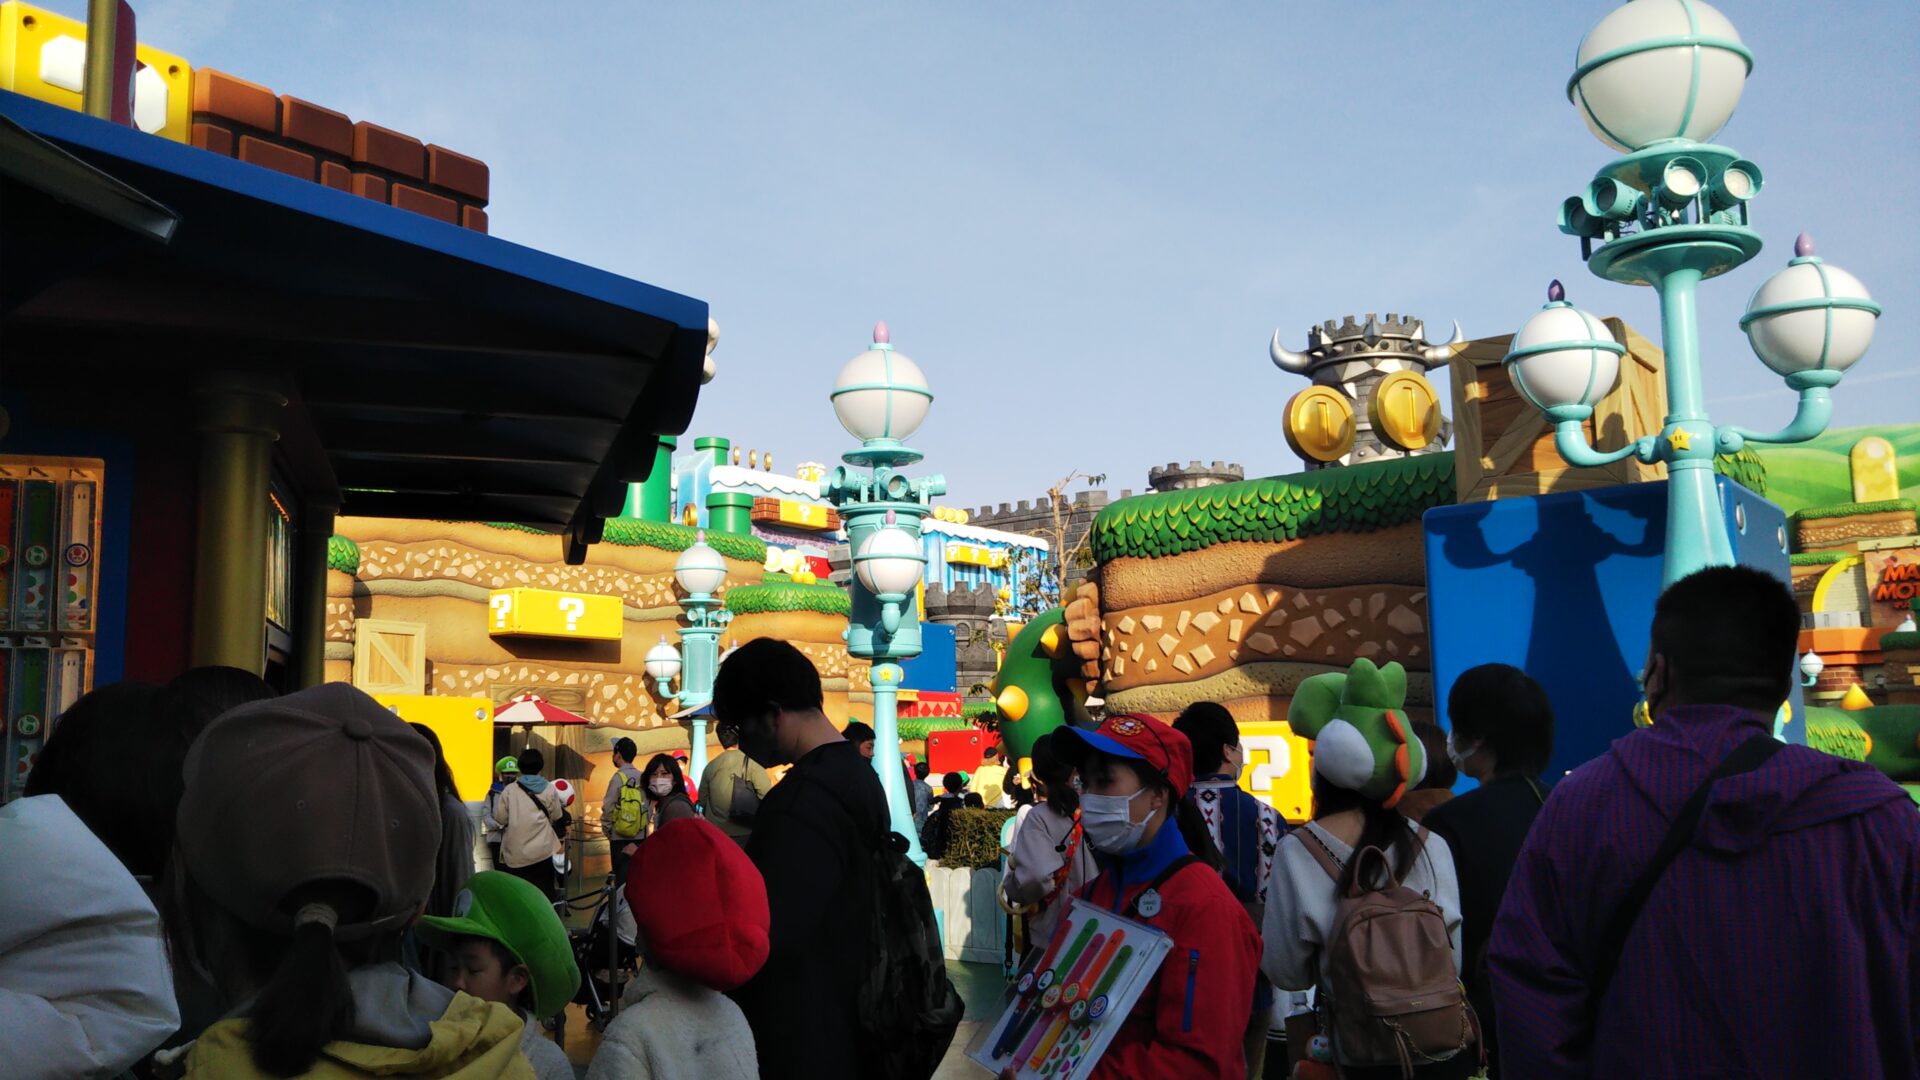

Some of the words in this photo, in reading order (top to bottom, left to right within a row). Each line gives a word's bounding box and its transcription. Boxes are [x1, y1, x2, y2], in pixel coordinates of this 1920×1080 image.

[491, 594, 512, 629] ?
[559, 597, 585, 631] ?
[1239, 735, 1291, 808] ?
